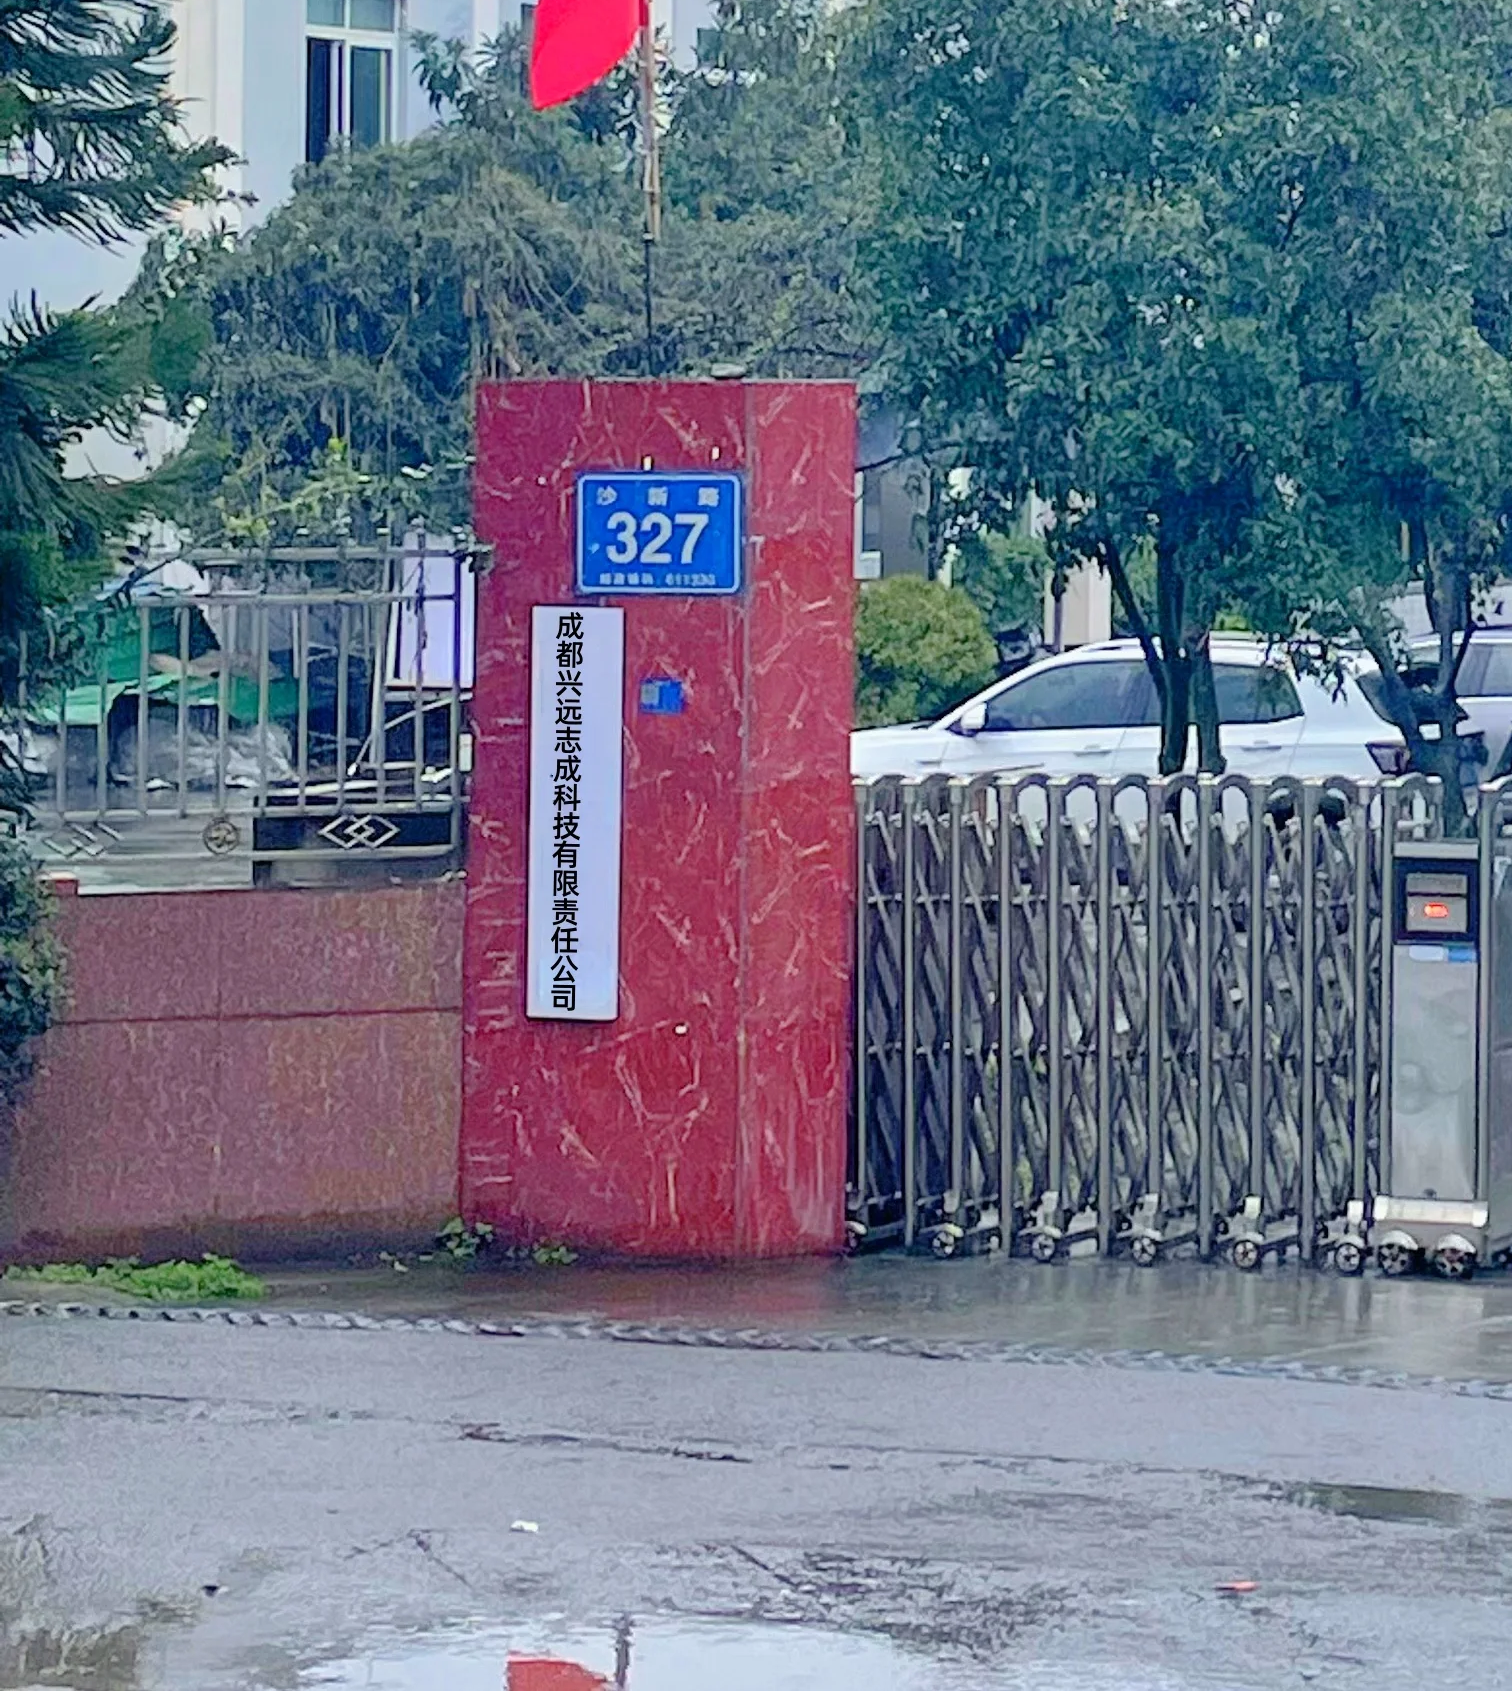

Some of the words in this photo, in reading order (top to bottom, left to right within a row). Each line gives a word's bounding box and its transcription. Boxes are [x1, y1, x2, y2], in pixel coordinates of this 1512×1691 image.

[606, 511, 709, 565] 327
[550, 611, 584, 1011] 成都兴远志成科技有限责任公司
